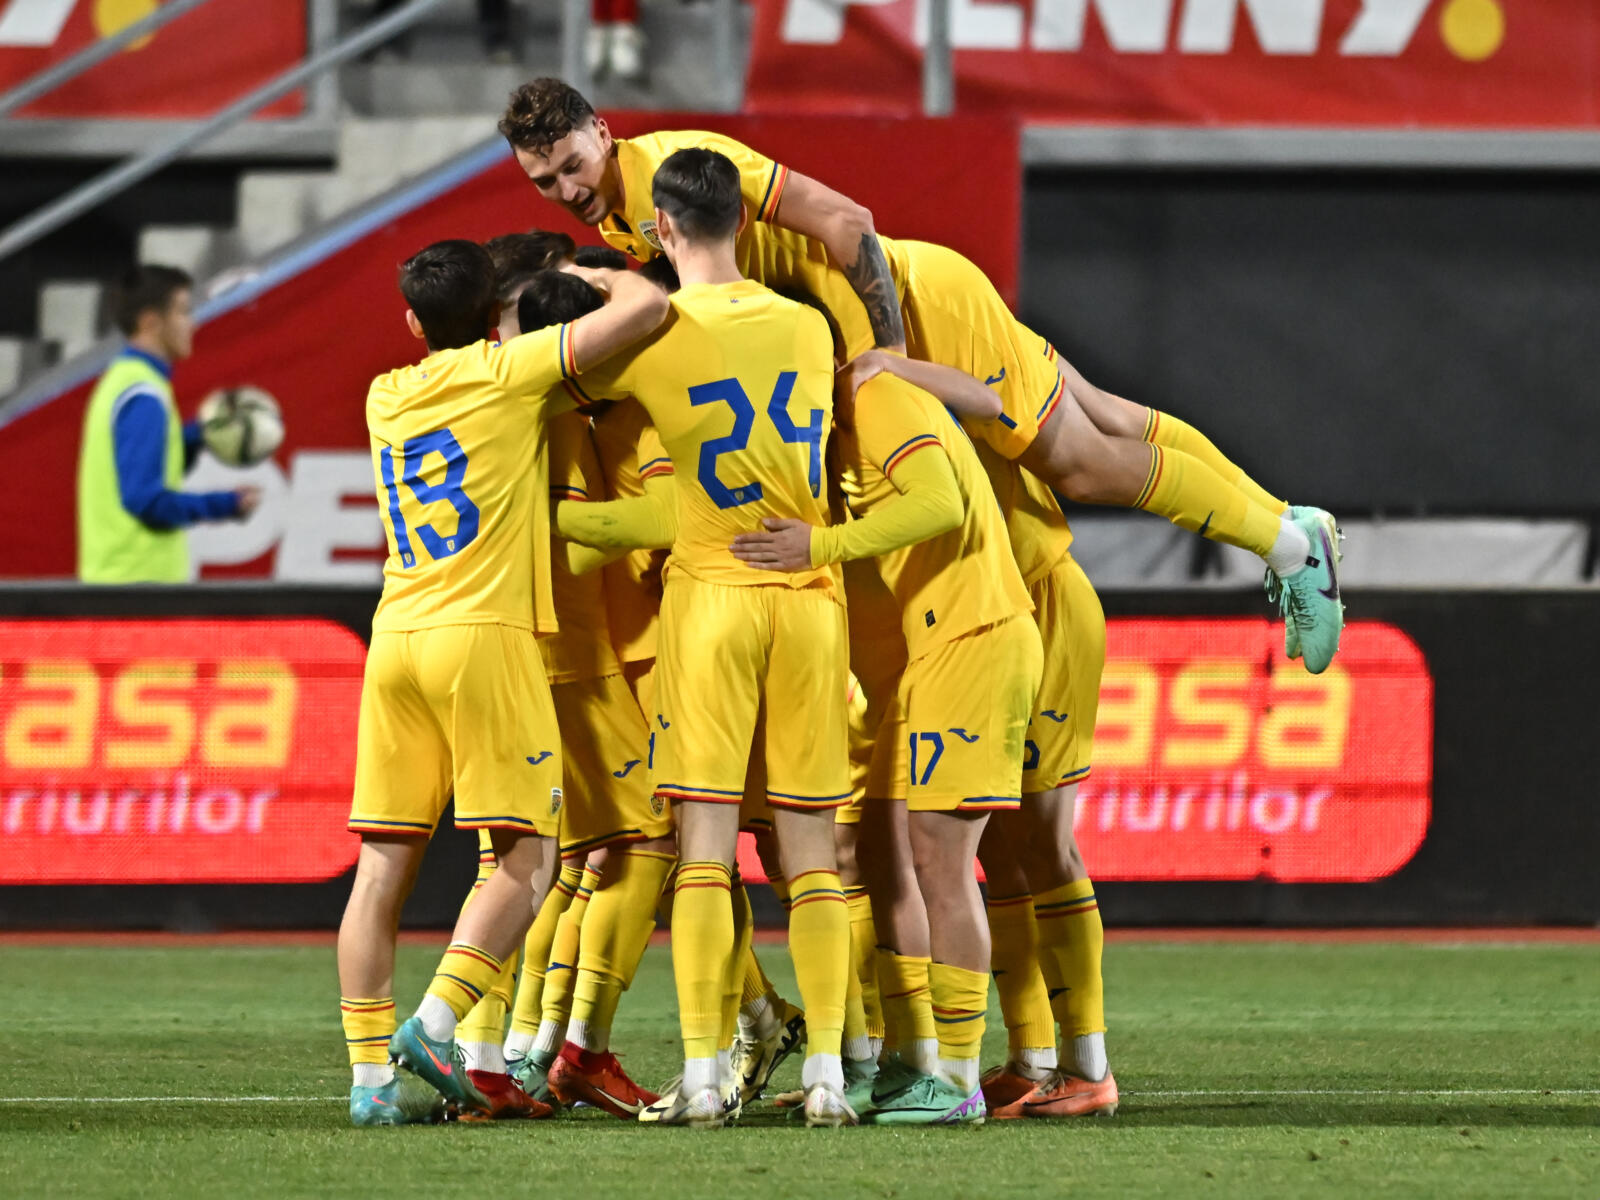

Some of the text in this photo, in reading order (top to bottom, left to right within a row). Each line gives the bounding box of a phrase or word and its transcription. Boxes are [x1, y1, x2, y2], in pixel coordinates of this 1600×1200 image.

[380, 427, 480, 570] 19
[688, 371, 825, 510] 24
[0, 657, 299, 769] asa
[909, 732, 944, 786] 17
